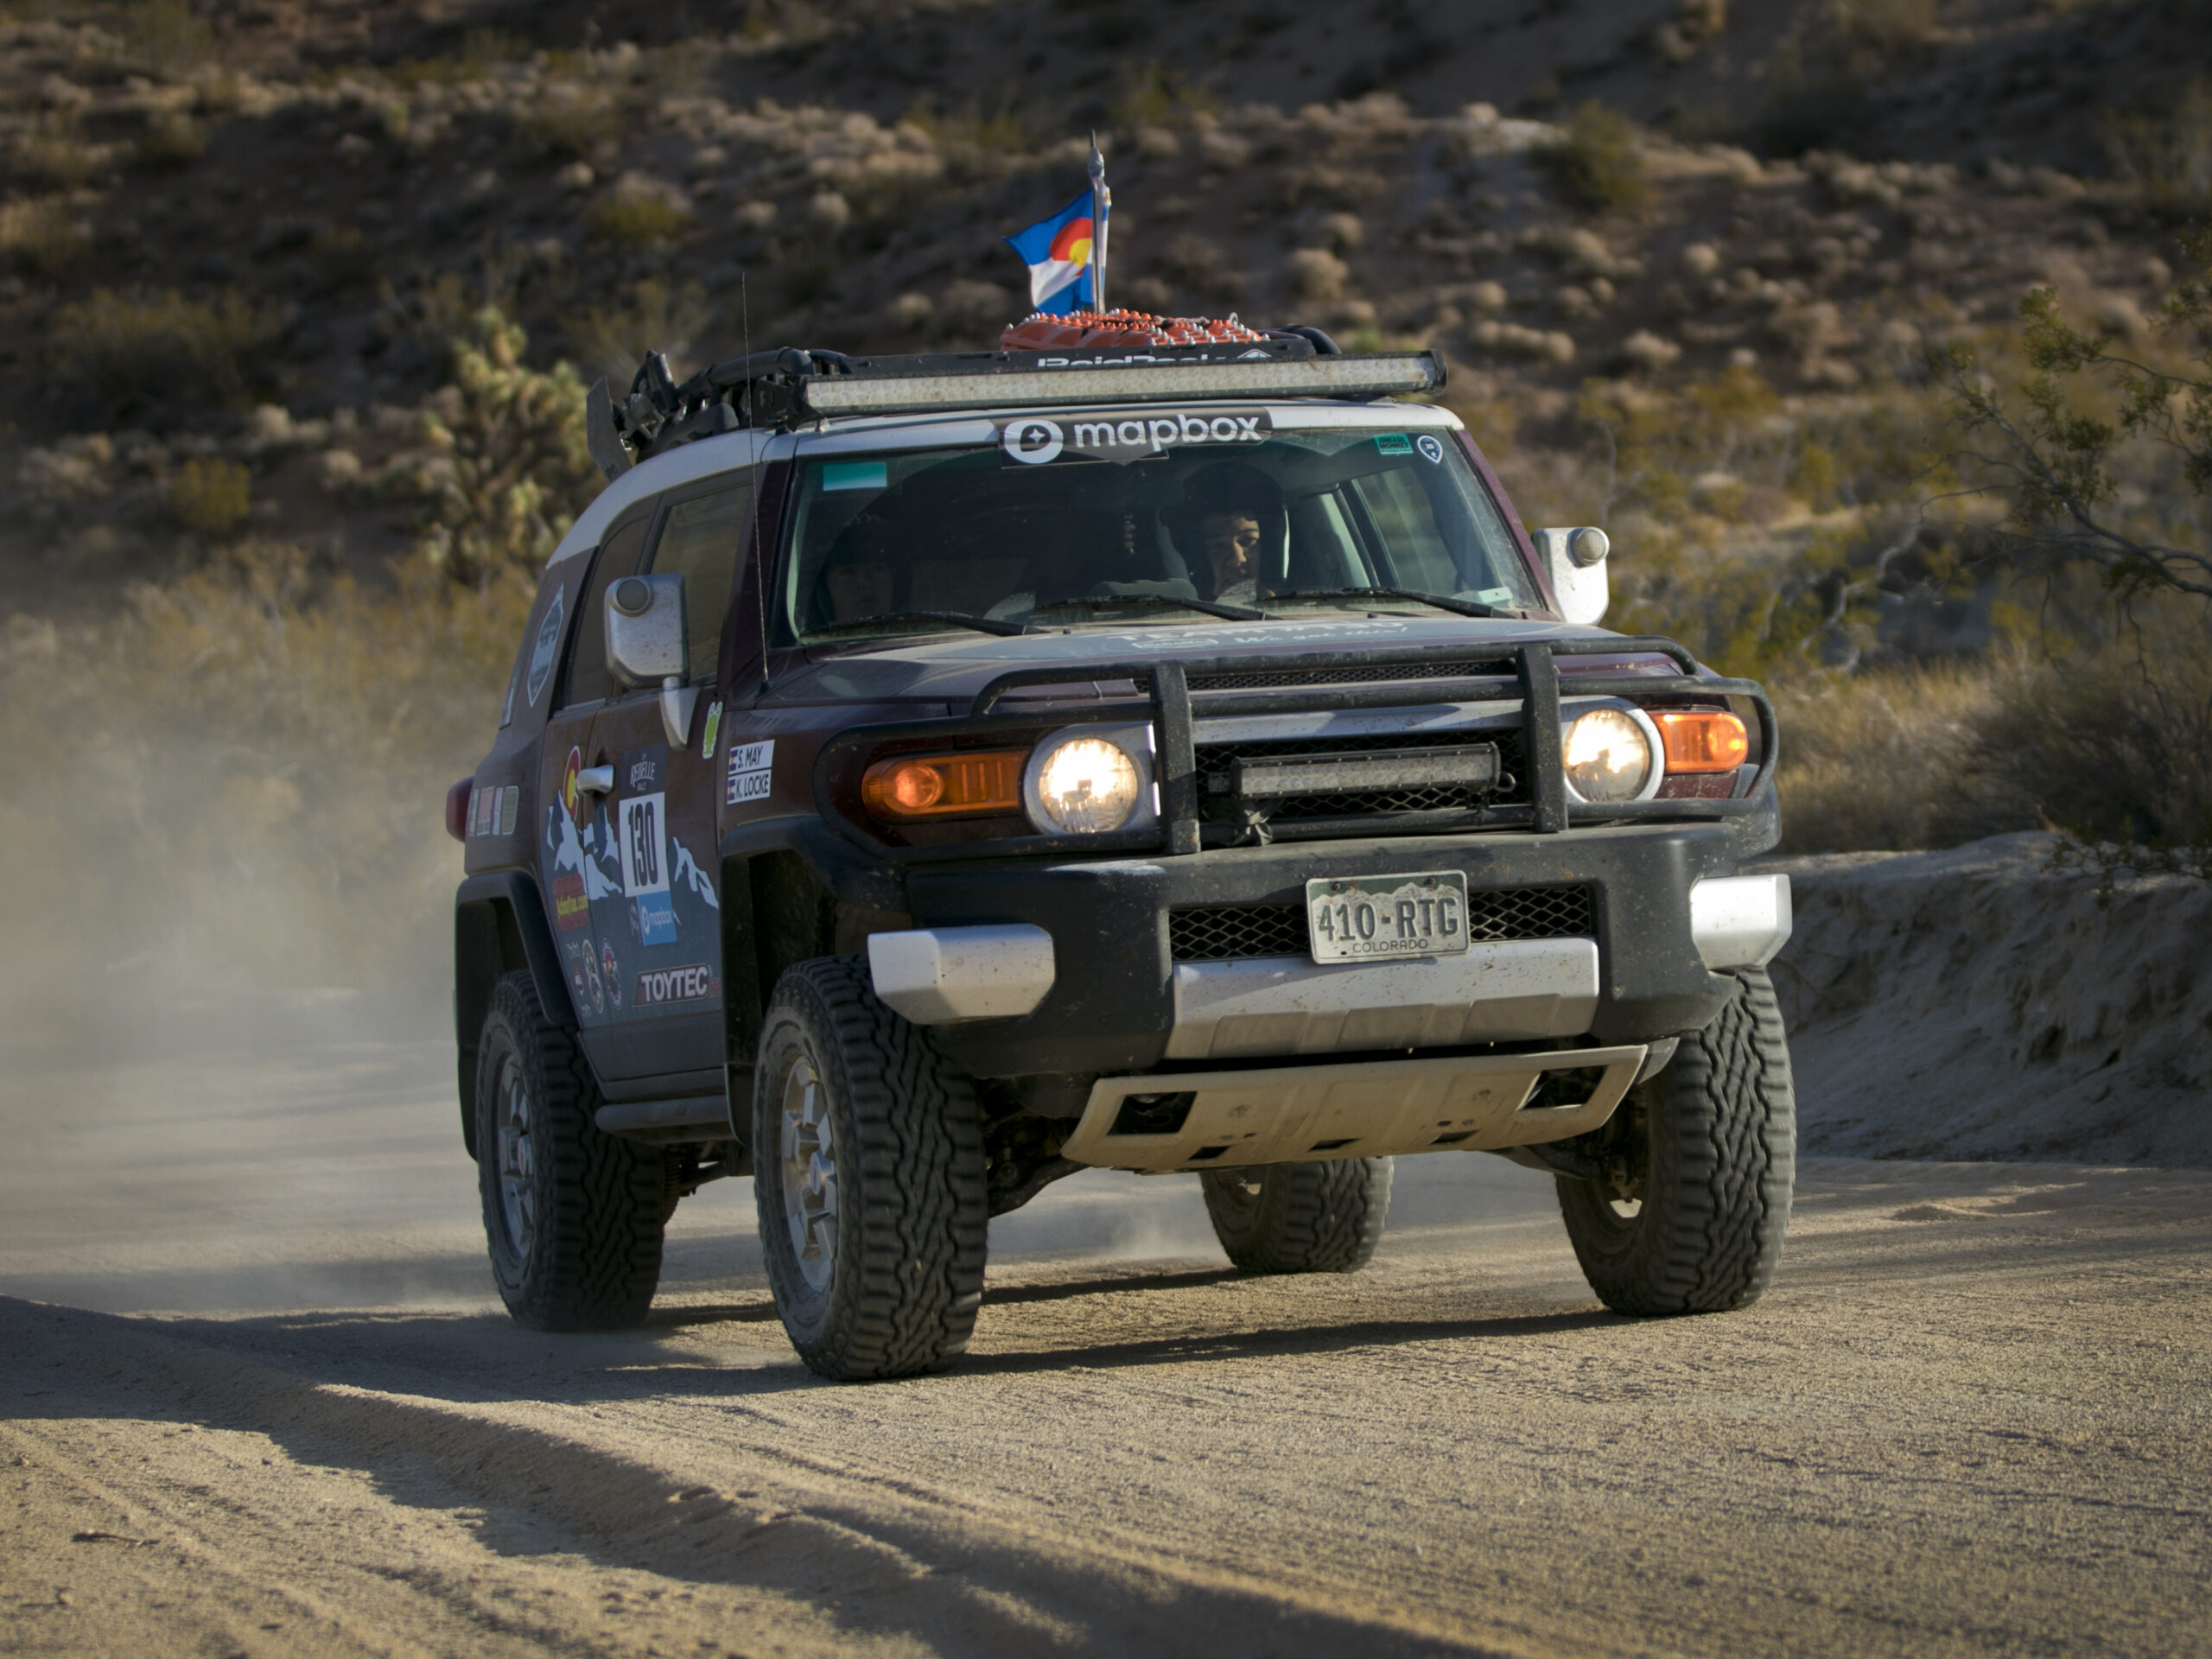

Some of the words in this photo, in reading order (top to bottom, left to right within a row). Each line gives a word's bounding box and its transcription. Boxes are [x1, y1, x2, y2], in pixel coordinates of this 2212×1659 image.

[1073, 414, 1262, 451] mapbox
[737, 750, 744, 769] S.
[745, 745, 764, 767] MAY
[630, 760, 657, 788] REBELLE
[735, 778, 743, 798] K.
[744, 773, 769, 797] LOCKE
[627, 800, 658, 887] 130
[649, 906, 672, 930] mapbox
[1319, 898, 1459, 941] 410-RTG
[1352, 938, 1429, 953] COLORADO
[641, 966, 709, 1002] TOYTEC
